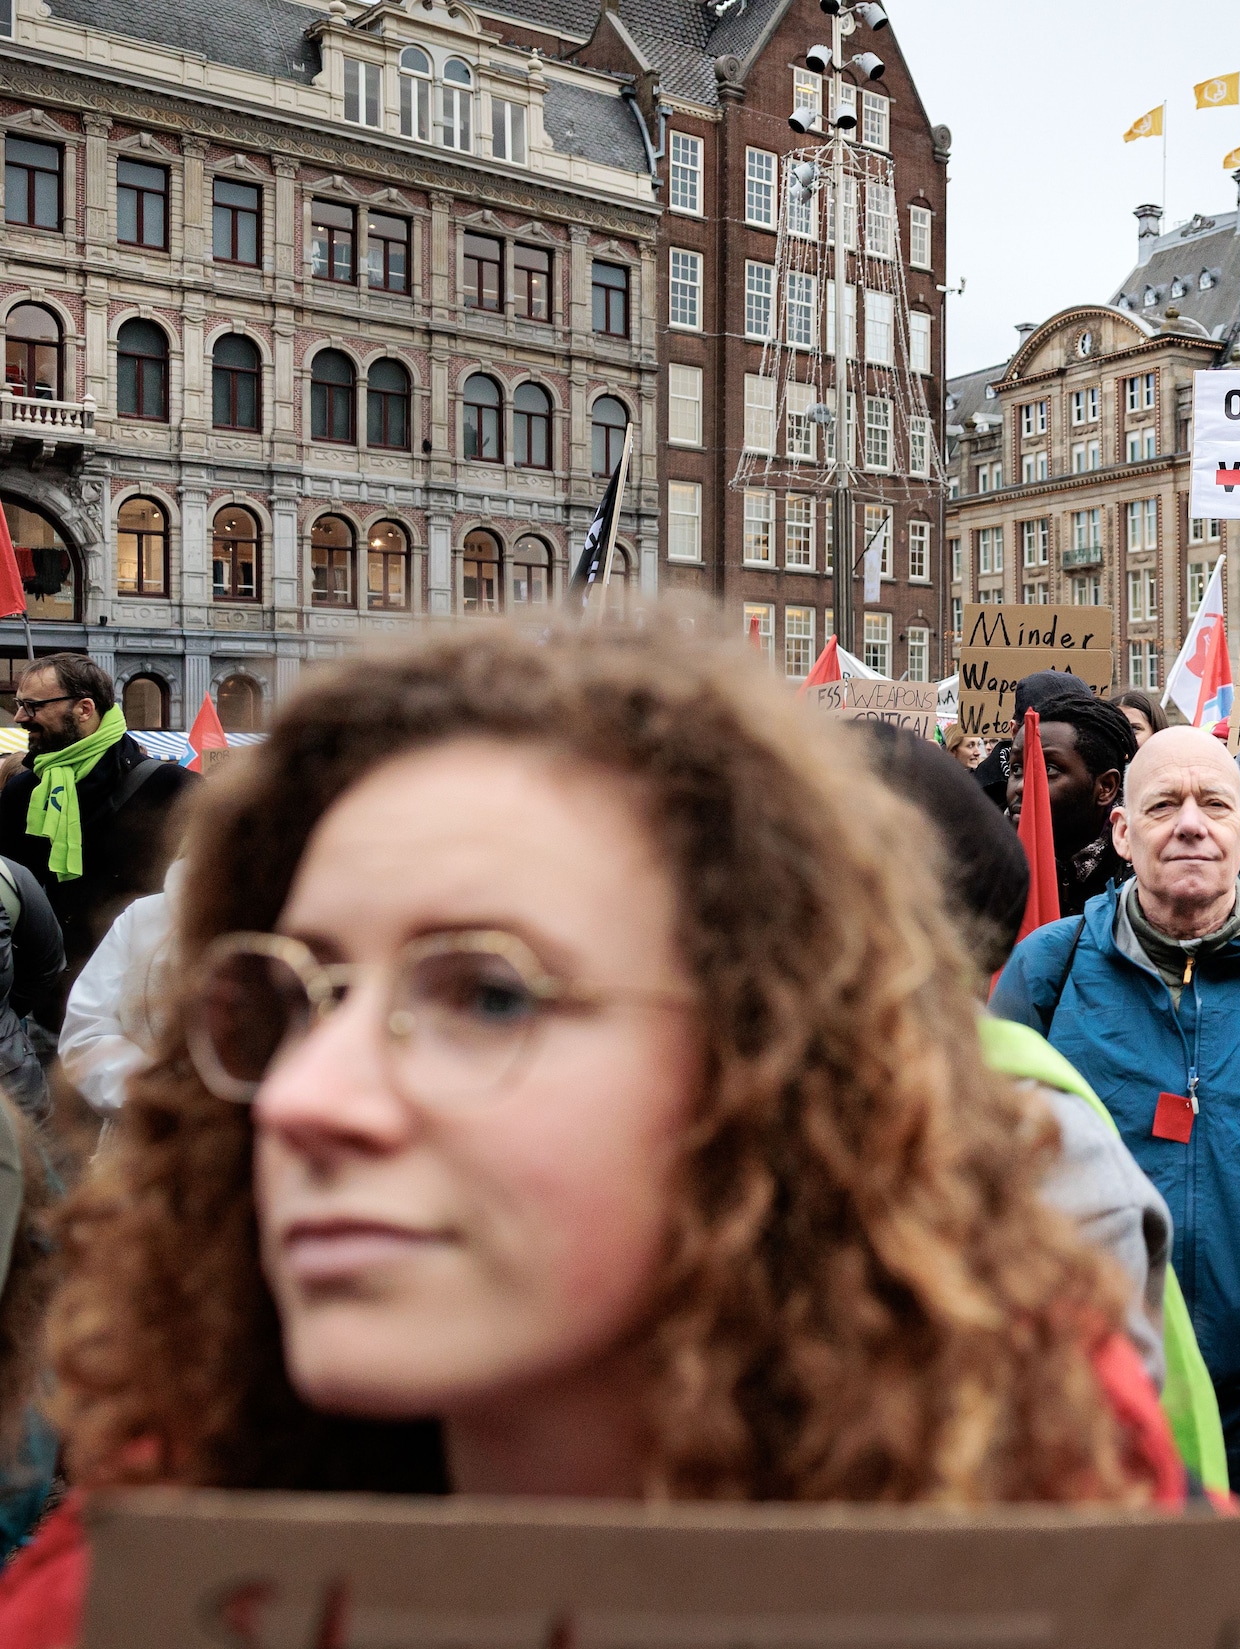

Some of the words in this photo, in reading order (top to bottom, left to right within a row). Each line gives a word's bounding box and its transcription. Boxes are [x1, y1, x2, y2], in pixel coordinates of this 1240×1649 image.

[969, 611, 1094, 649] Minder
[850, 682, 935, 709] WEAPONS
[962, 660, 1018, 708] Wape
[960, 701, 1012, 735] Wete
